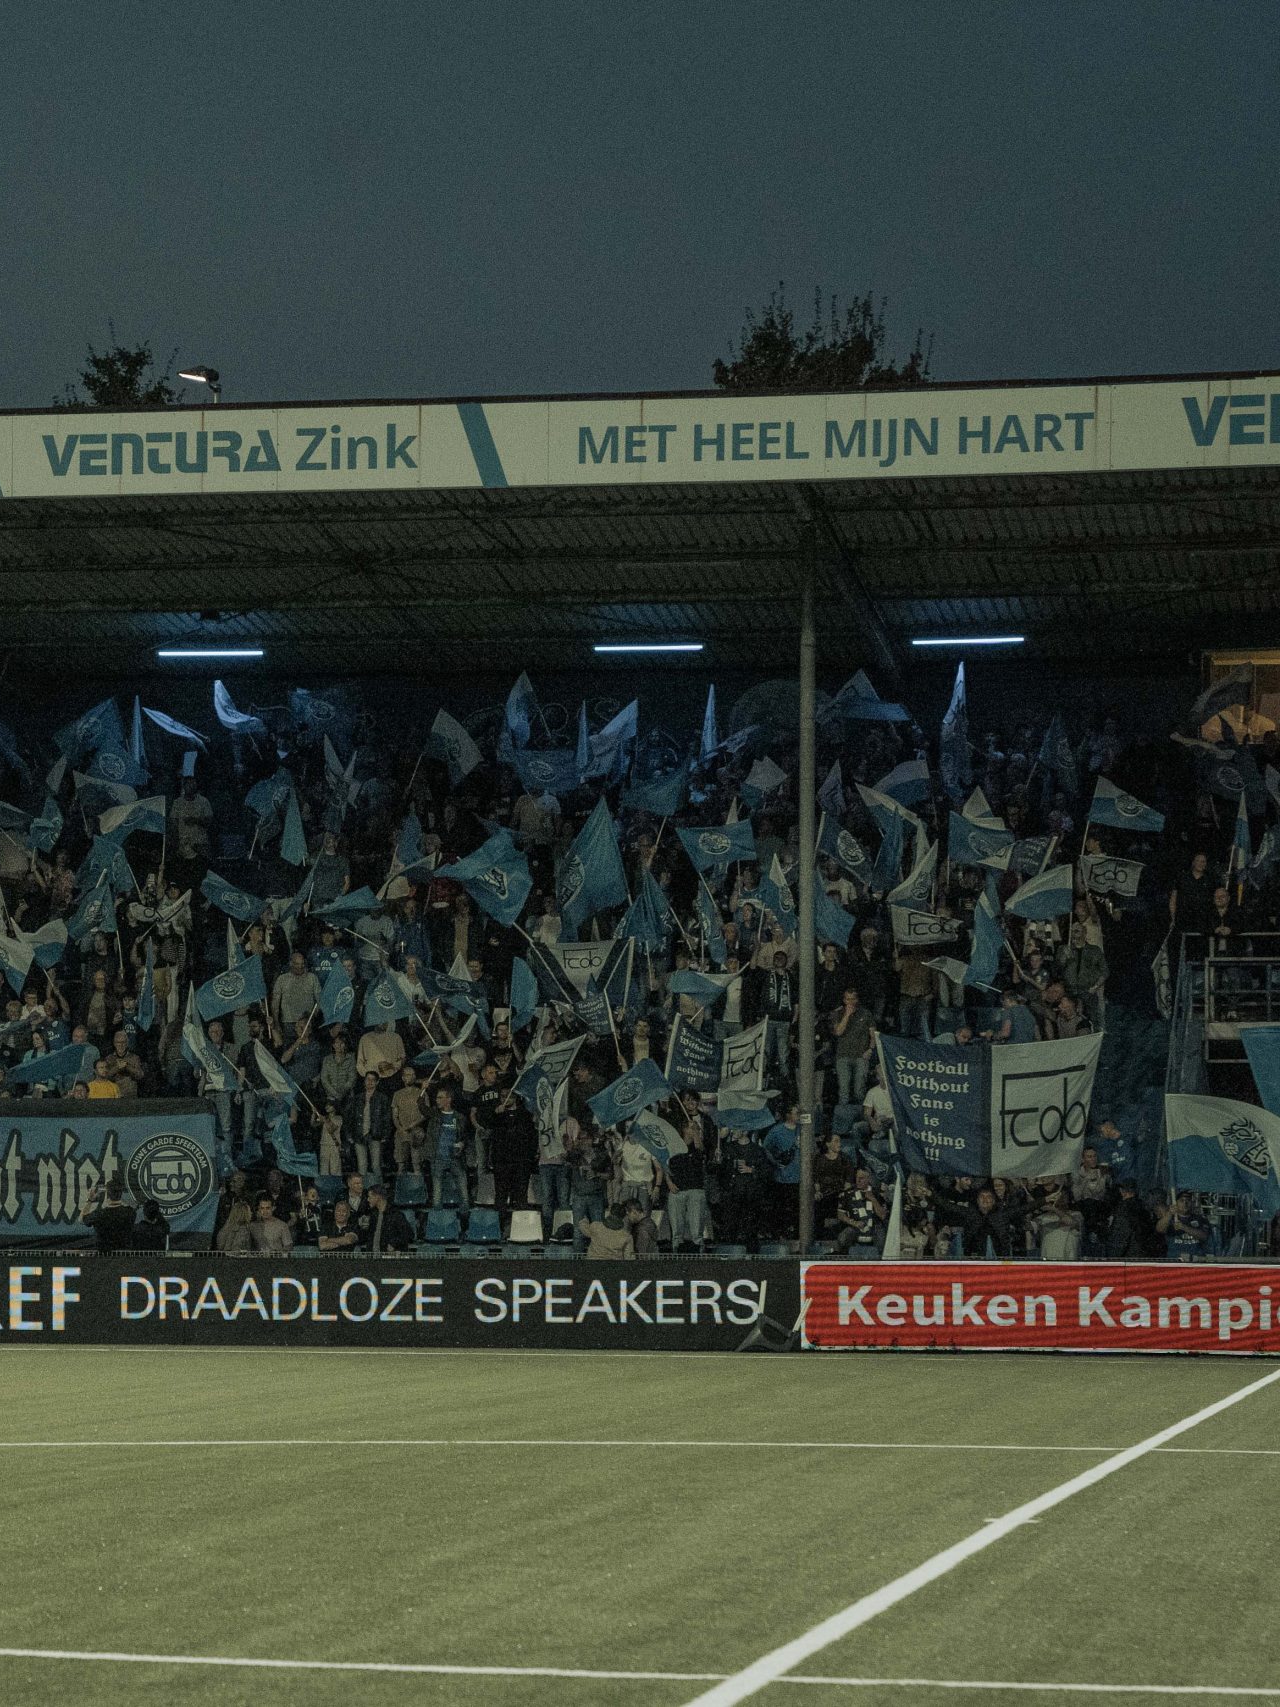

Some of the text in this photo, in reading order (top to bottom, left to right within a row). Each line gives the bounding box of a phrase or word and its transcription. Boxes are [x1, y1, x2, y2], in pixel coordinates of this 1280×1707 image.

[41, 423, 418, 477] VENTURA Zink
[578, 412, 1095, 467] MET HEEL MIJN HART
[895, 1055, 970, 1076] Football
[897, 1072, 970, 1095] Without
[909, 1093, 955, 1110] Fans
[923, 1113, 940, 1127] is
[905, 1126, 966, 1150] nothing
[131, 1146, 149, 1170] OUWE
[147, 1137, 174, 1150] GARDE
[924, 1146, 940, 1161] !!!
[35, 1131, 118, 1221] niet
[167, 1200, 193, 1215] BOSCH
[119, 1275, 444, 1322] DRAADLOZE
[474, 1277, 760, 1326] SPEAKERS
[837, 1282, 1280, 1341] Keuken Kampi
